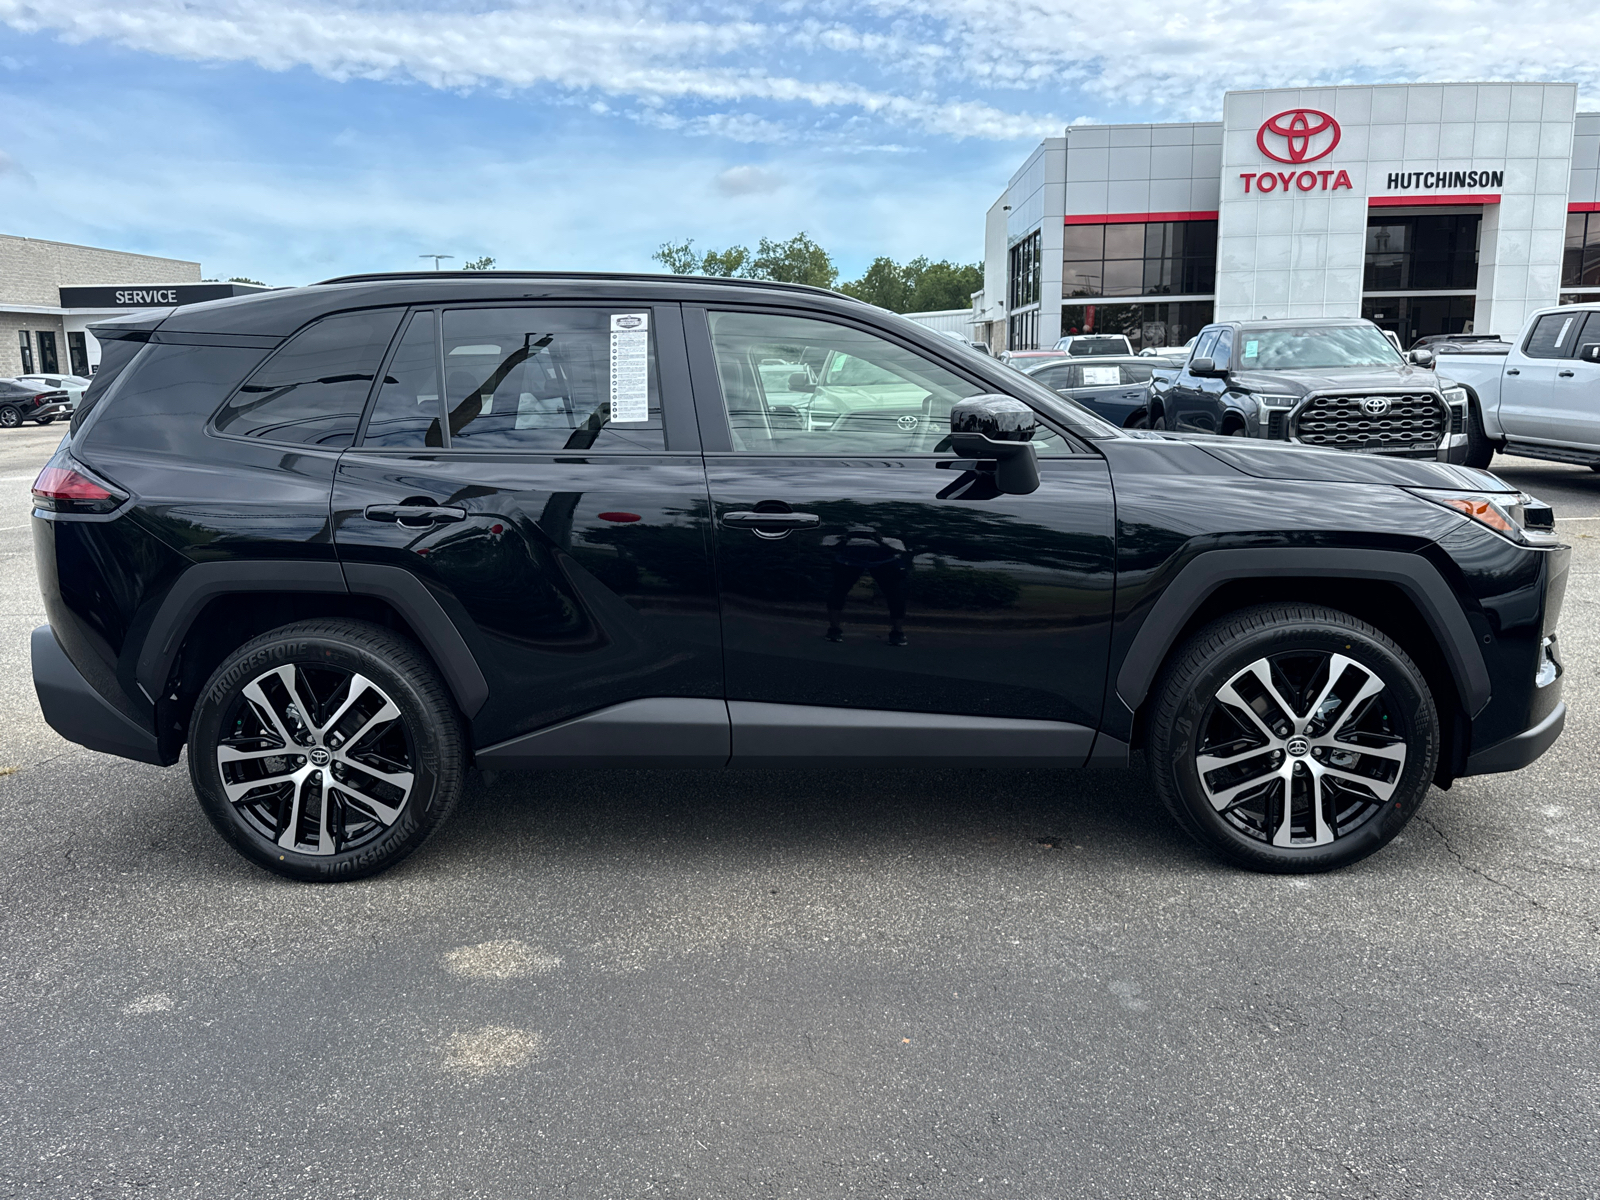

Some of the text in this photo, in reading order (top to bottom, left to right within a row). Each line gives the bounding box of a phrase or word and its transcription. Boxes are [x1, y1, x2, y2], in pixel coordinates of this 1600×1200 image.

[1240, 170, 1353, 193] TOYOTA
[1387, 171, 1504, 189] HUTCHINSON
[115, 290, 177, 304] SERVICE
[1271, 628, 1393, 666] BRIDGESTONE
[209, 642, 307, 704] BRIDGESTONE
[1403, 732, 1433, 817] TURANZA
[321, 814, 419, 875] BRIDGESTONE
